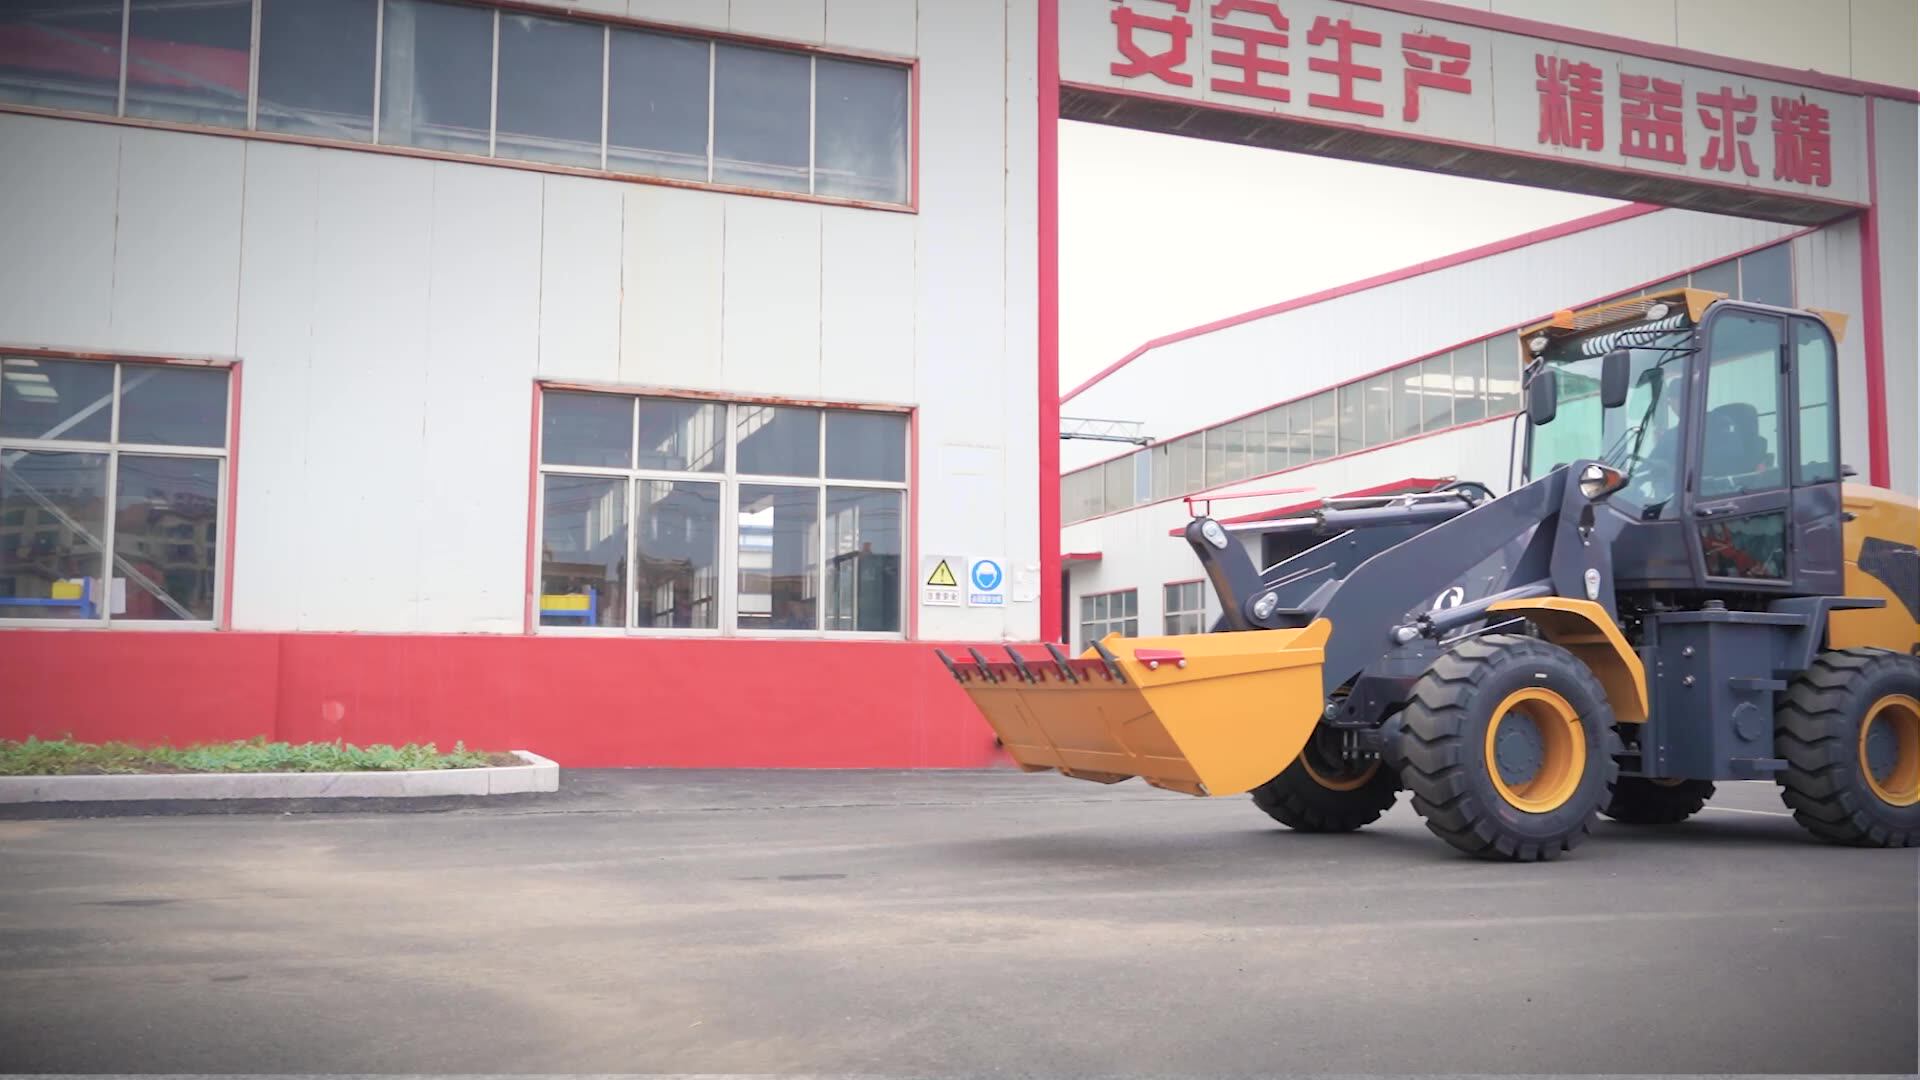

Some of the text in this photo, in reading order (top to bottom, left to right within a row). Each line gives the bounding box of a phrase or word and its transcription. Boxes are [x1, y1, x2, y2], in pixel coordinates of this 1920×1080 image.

[1110, 0, 1832, 187] 安全生产 精益求精
